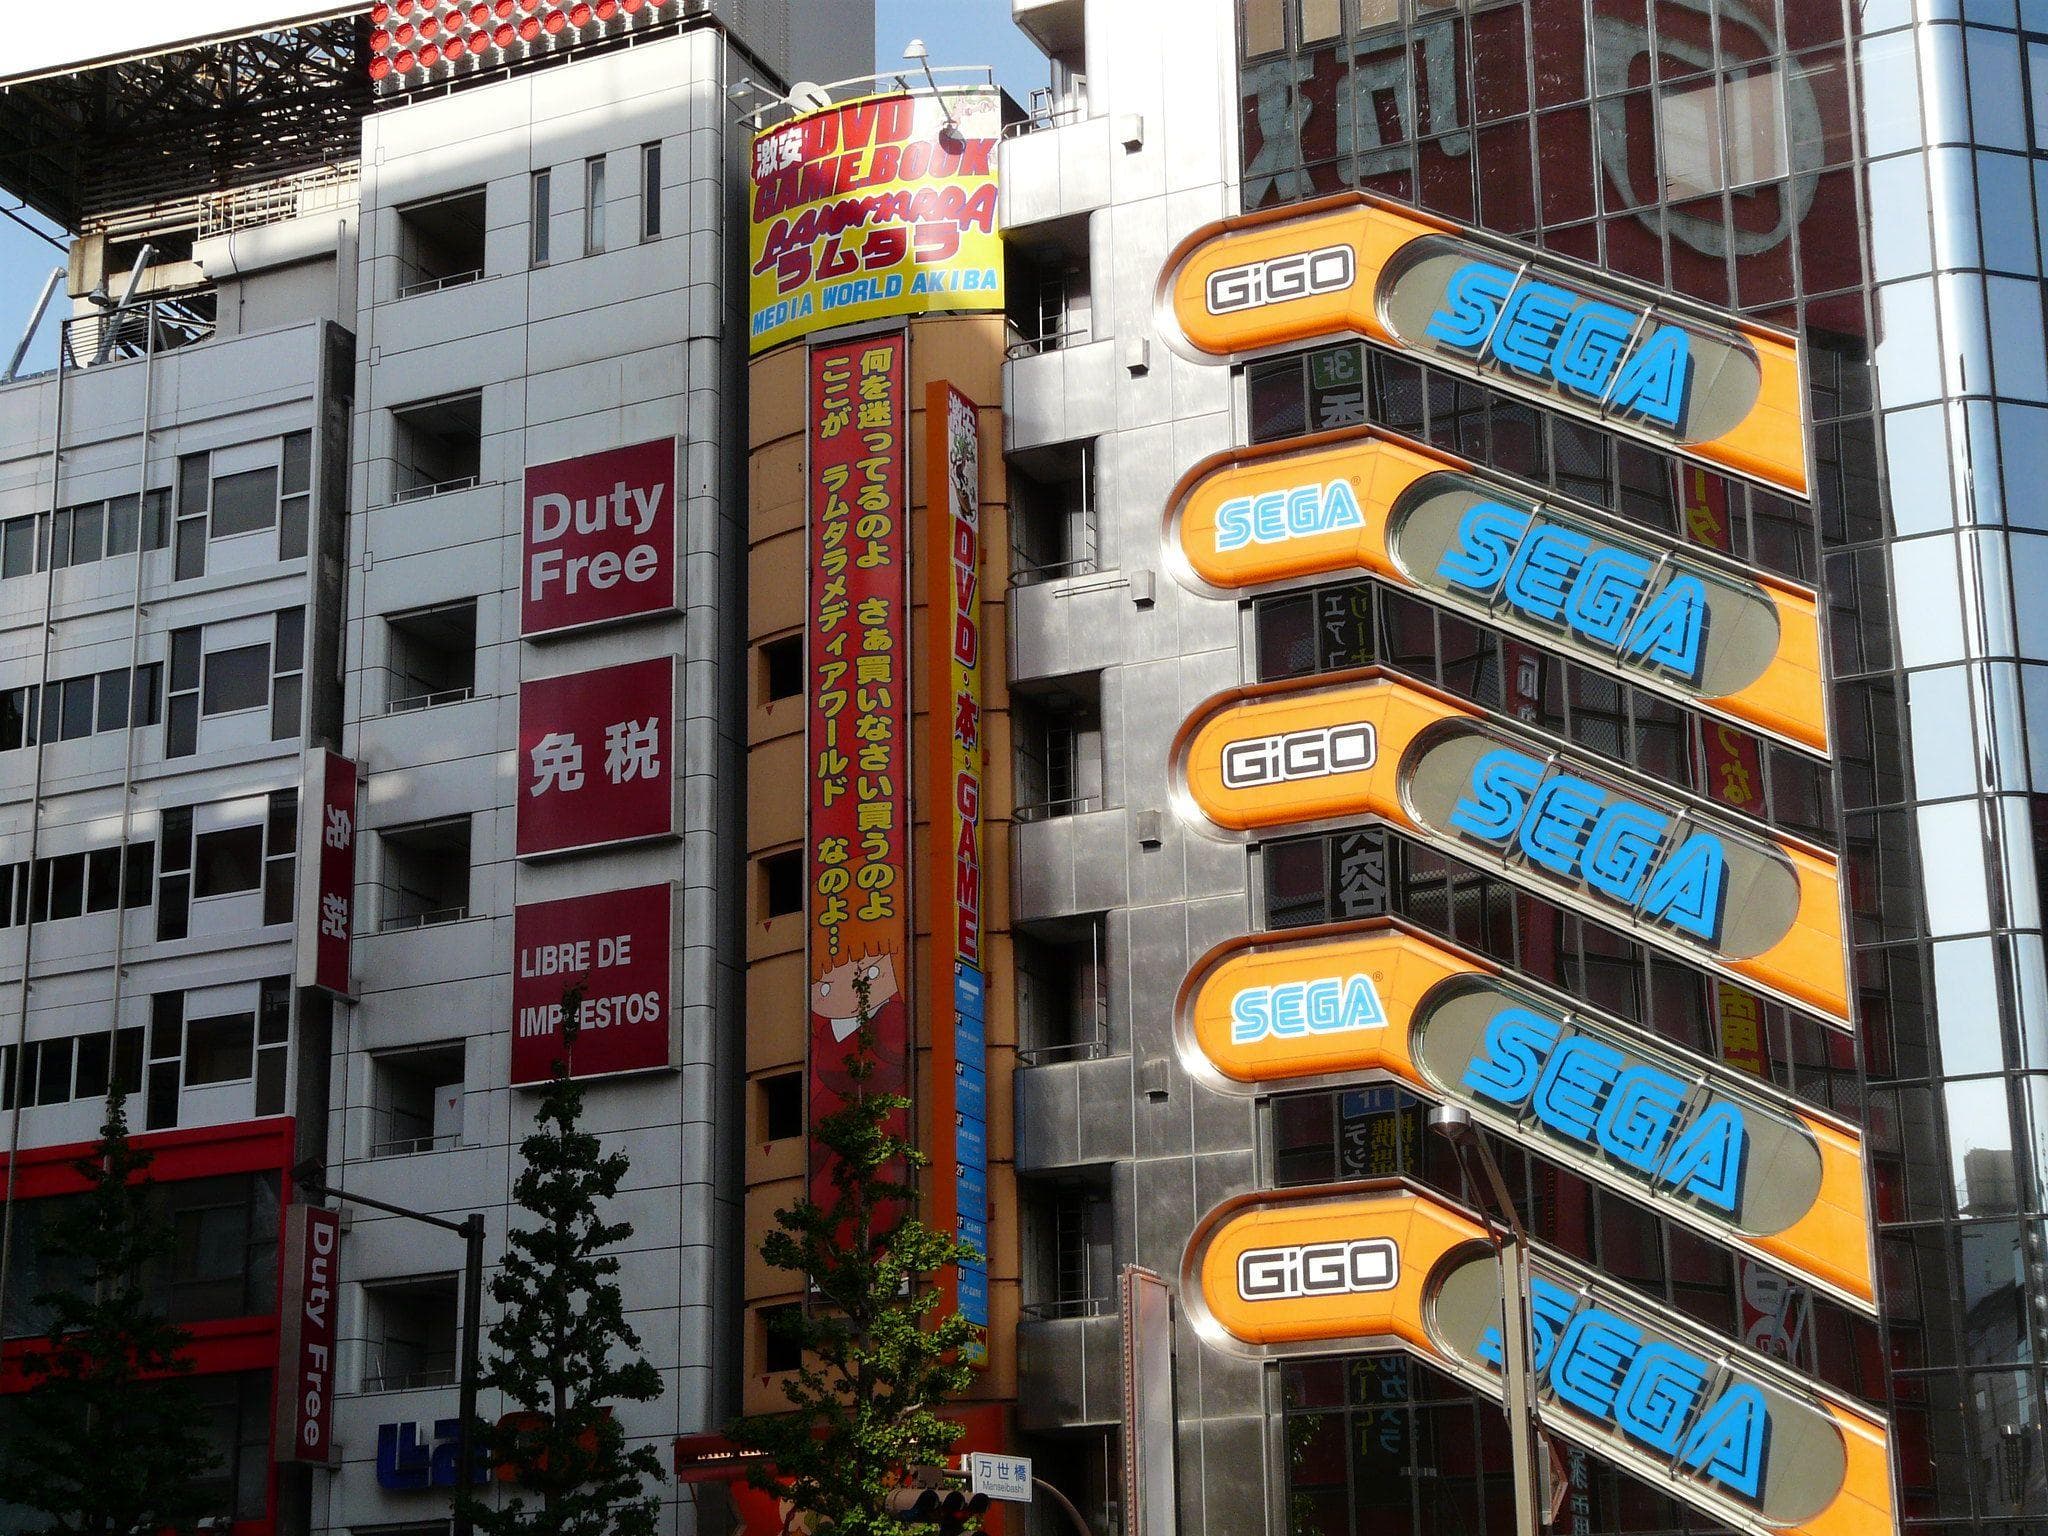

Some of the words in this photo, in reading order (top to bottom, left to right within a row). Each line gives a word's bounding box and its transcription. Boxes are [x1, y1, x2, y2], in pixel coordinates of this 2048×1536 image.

[756, 127, 803, 181] 激安
[804, 94, 915, 161] DVD
[776, 222, 960, 295] ラムタラ
[752, 292, 814, 337] MEDIA
[822, 273, 903, 310] WORLD
[910, 268, 998, 294] AKIBA
[1426, 263, 1688, 422] SEGA
[820, 356, 851, 440] ここが
[856, 347, 894, 568] 何を迷ってるのよ
[532, 481, 665, 545] Duty
[1216, 478, 1366, 553] SEGA
[531, 543, 658, 602] Free
[1438, 502, 1705, 674] SEGA
[530, 716, 662, 798] 免税
[856, 597, 895, 922] さあ買いなさい買うのよ
[321, 803, 351, 941] 免税
[1451, 749, 1724, 939] SEGA
[521, 940, 591, 979] LIBRE
[597, 934, 632, 968] DE
[520, 990, 660, 1038] IMPESTOS
[1232, 974, 1388, 1045] SEGA
[1463, 1008, 1744, 1211] SEGA
[305, 1221, 334, 1329] Duty
[303, 1343, 329, 1447] Free
[979, 1459, 1027, 1483] 万世橋
[982, 1480, 1025, 1495] Manseibashi
